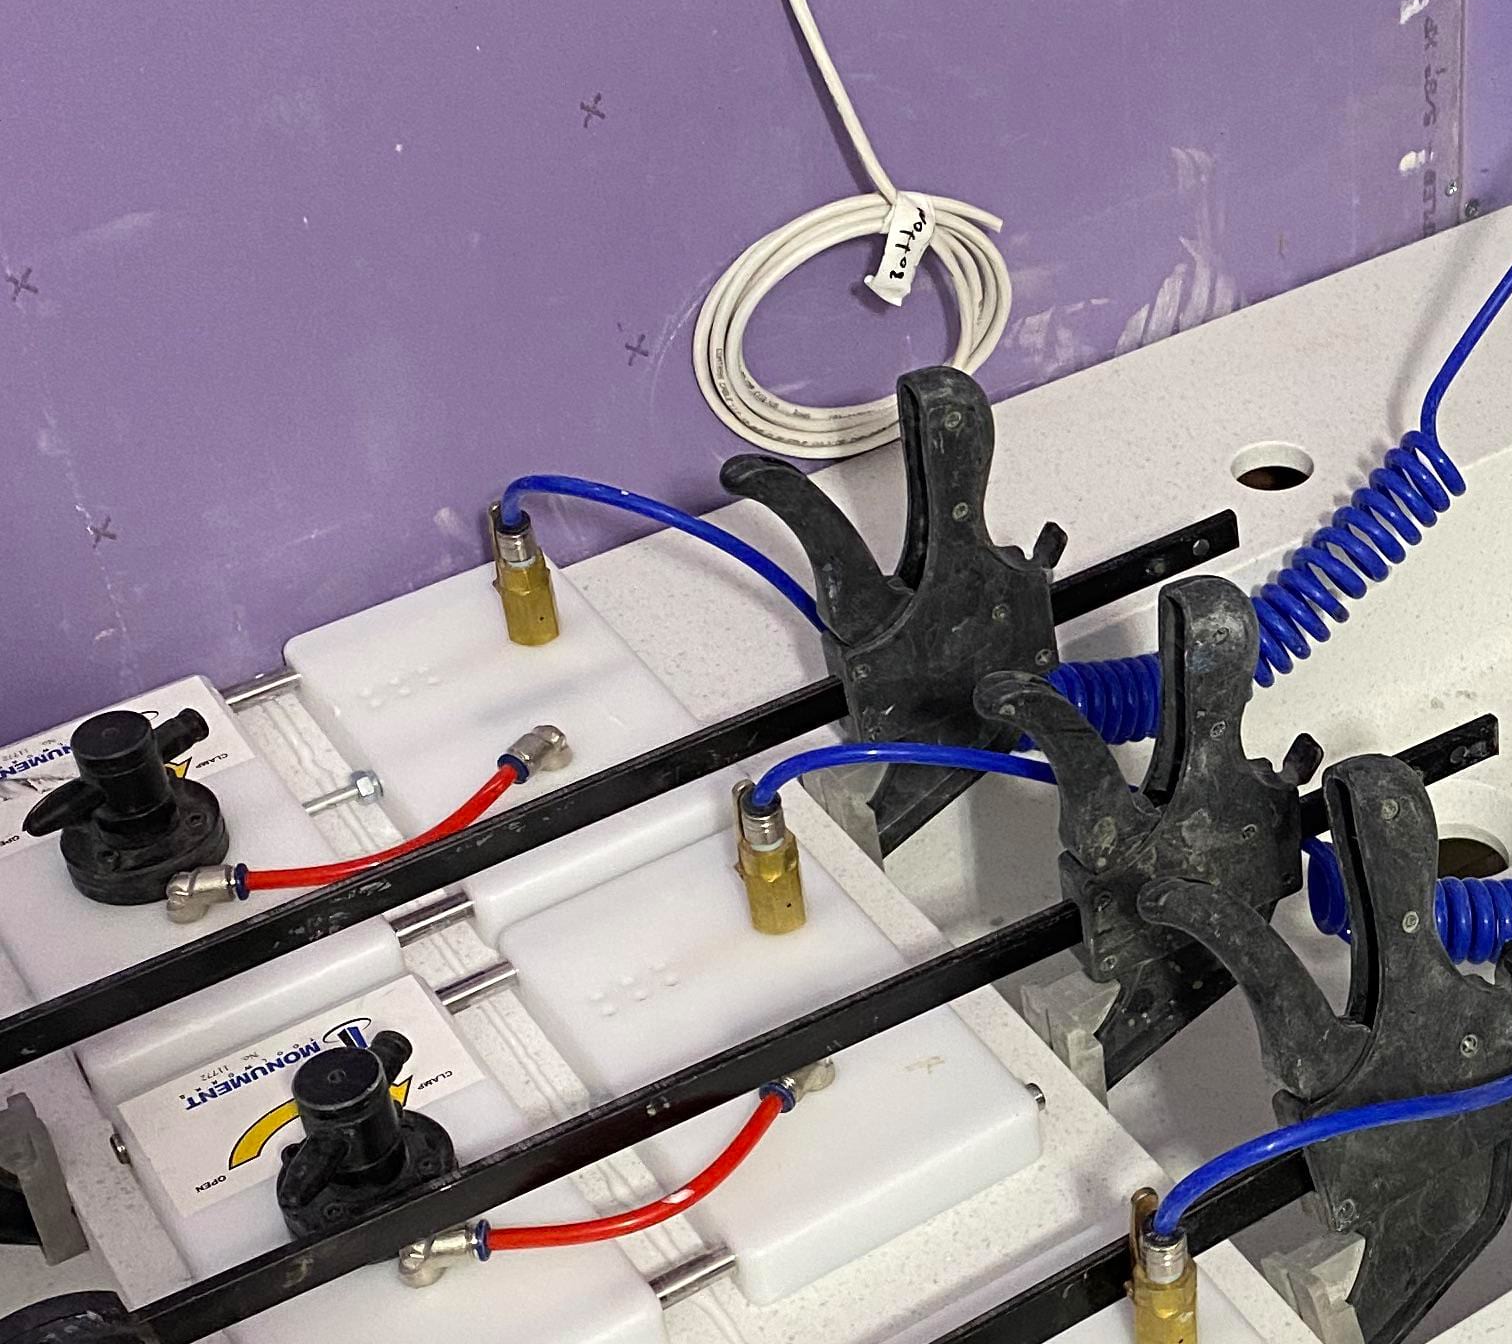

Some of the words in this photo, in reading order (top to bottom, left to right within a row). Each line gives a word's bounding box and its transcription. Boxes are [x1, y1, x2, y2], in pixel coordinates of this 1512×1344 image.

[195, 753, 229, 769] CLAMP
[185, 1040, 321, 1111] MONUMENT
[418, 1069, 453, 1090] CLAMP
[195, 1175, 227, 1193] OPEN
